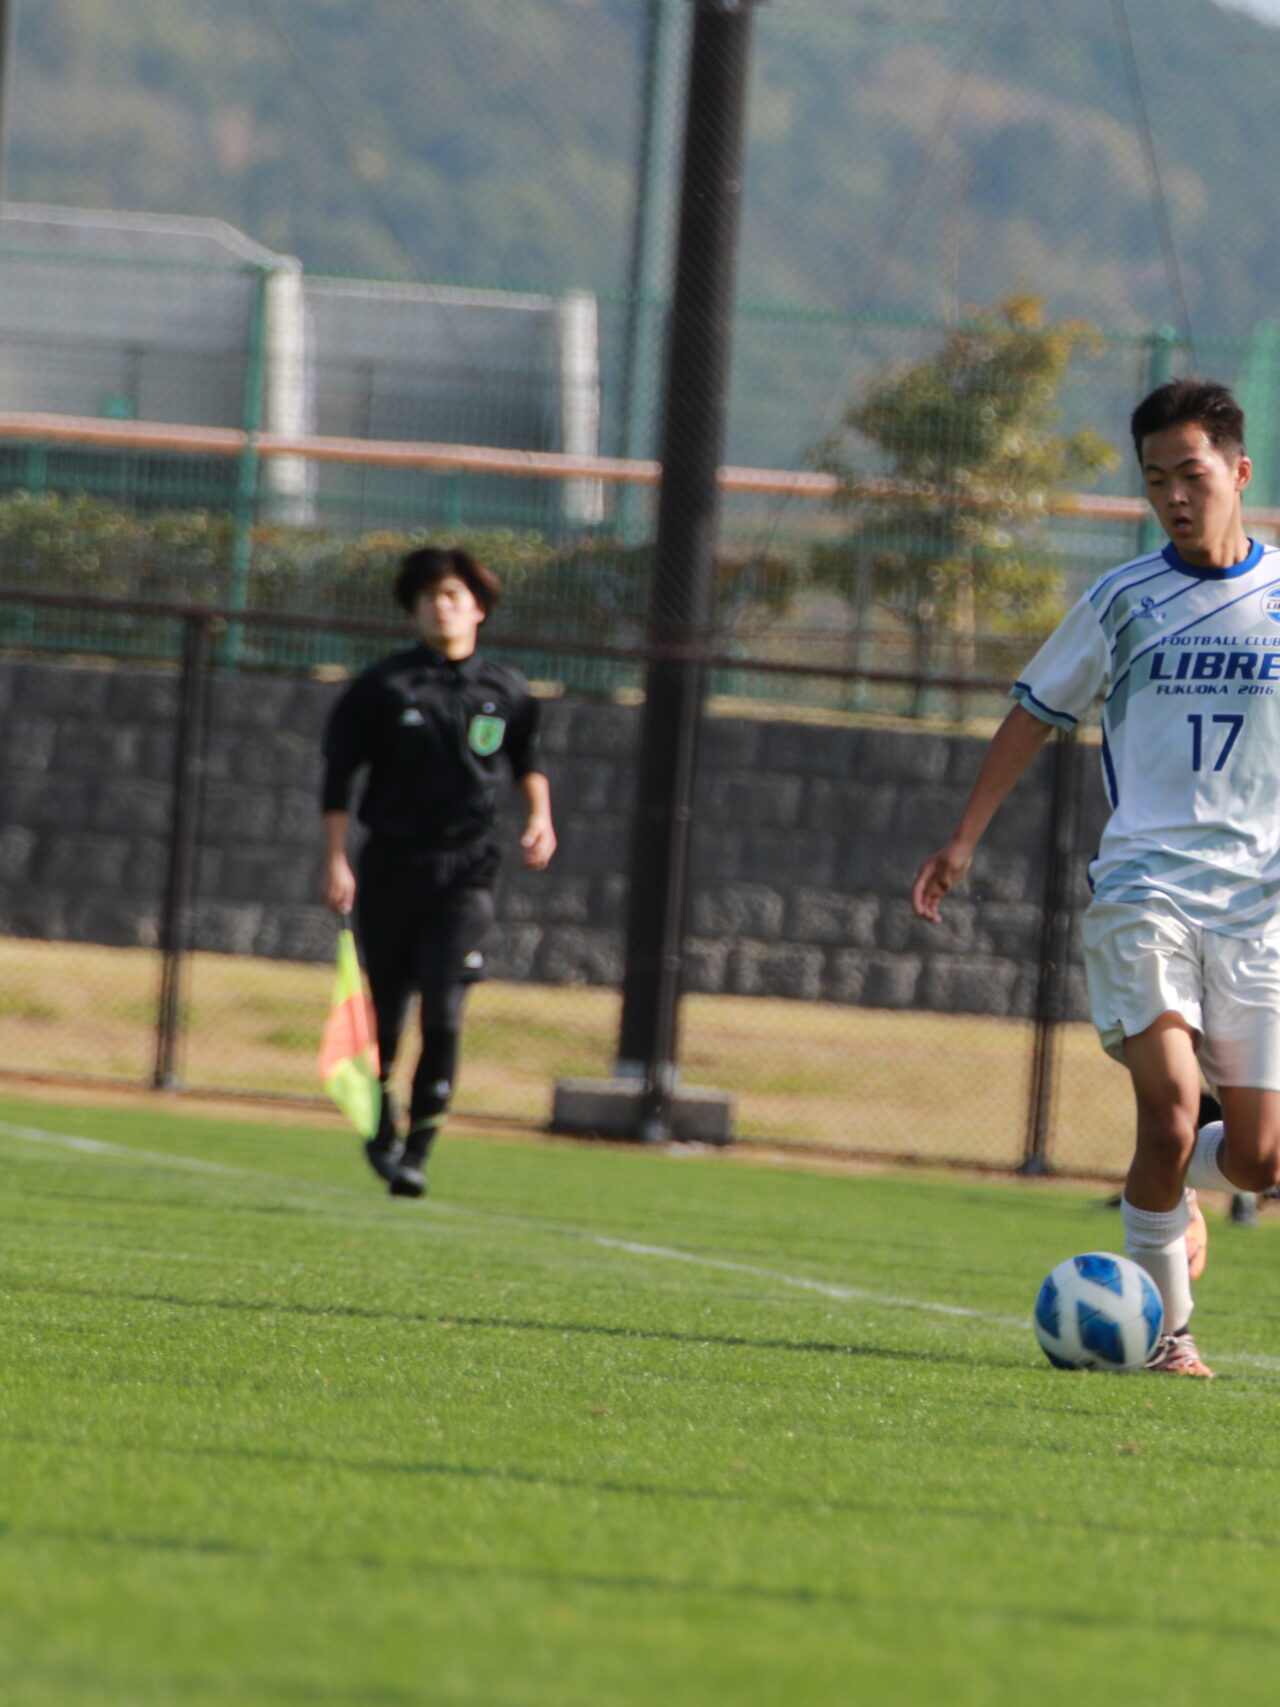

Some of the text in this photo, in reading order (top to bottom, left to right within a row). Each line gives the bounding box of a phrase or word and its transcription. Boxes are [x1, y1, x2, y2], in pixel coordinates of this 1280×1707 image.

[1160, 636, 1239, 646] FOOTBALL
[1156, 685, 1274, 695] FUKUOKA 2016
[1187, 714, 1244, 771] 17
